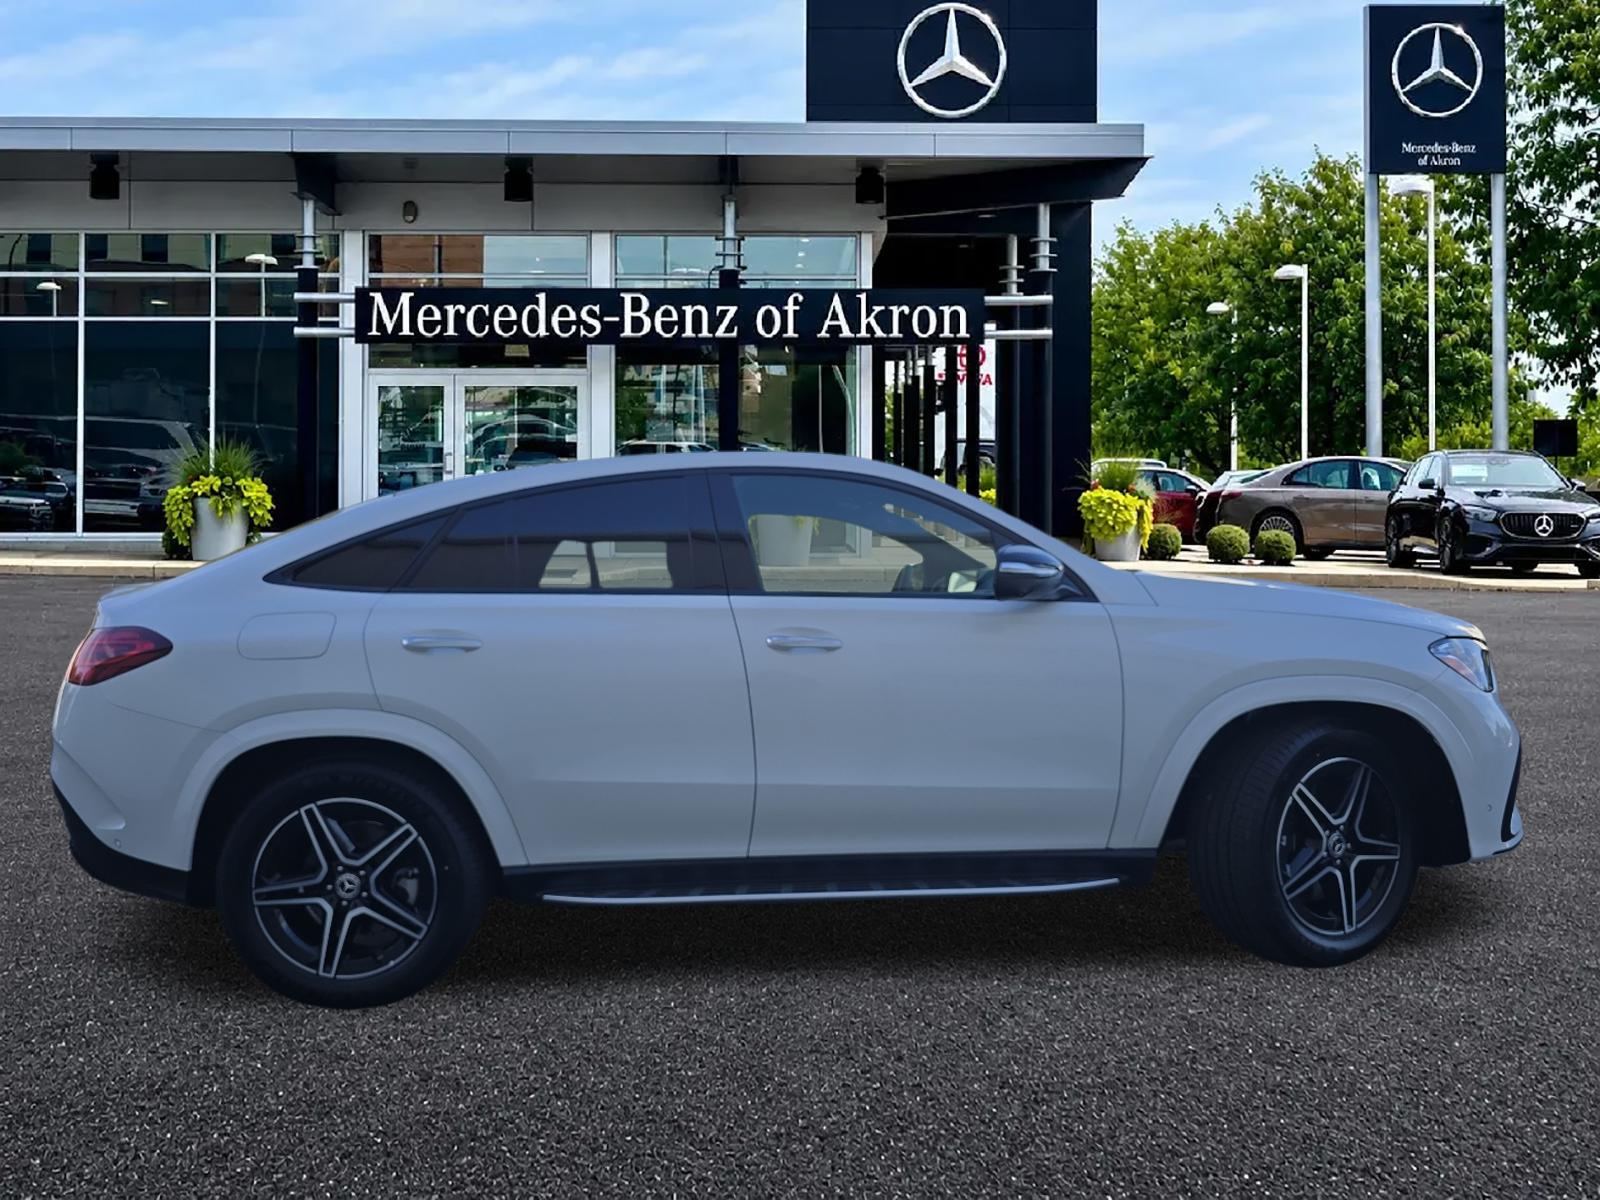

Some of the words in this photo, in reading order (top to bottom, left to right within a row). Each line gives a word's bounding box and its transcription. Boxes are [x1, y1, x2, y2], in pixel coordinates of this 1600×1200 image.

[1401, 142, 1476, 153] Mercedes-Benz
[1417, 154, 1428, 166] of
[1430, 154, 1461, 166] Akron
[367, 291, 738, 338] Mercedes-Benz
[756, 292, 804, 338] of
[817, 291, 969, 338] Akron
